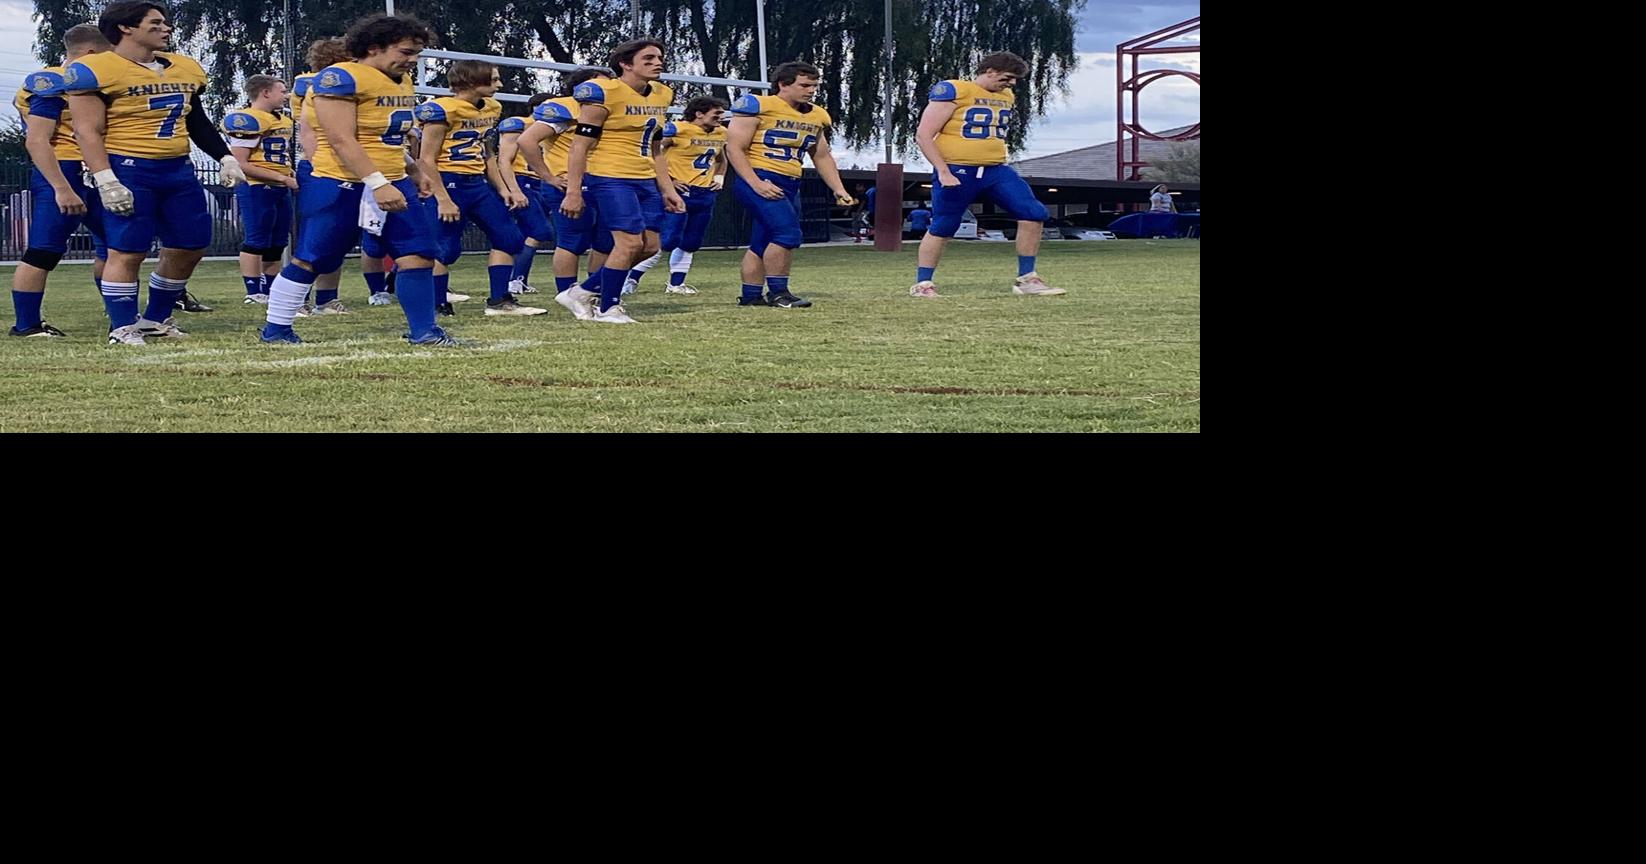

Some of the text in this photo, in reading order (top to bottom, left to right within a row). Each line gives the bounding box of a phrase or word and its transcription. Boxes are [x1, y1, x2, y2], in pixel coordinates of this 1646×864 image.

[127, 82, 197, 97] KNIGHTS
[147, 92, 186, 139] 7
[775, 119, 820, 132] KNIGHT
[447, 128, 490, 162] 2
[640, 116, 658, 159] 1
[691, 146, 717, 175] 4
